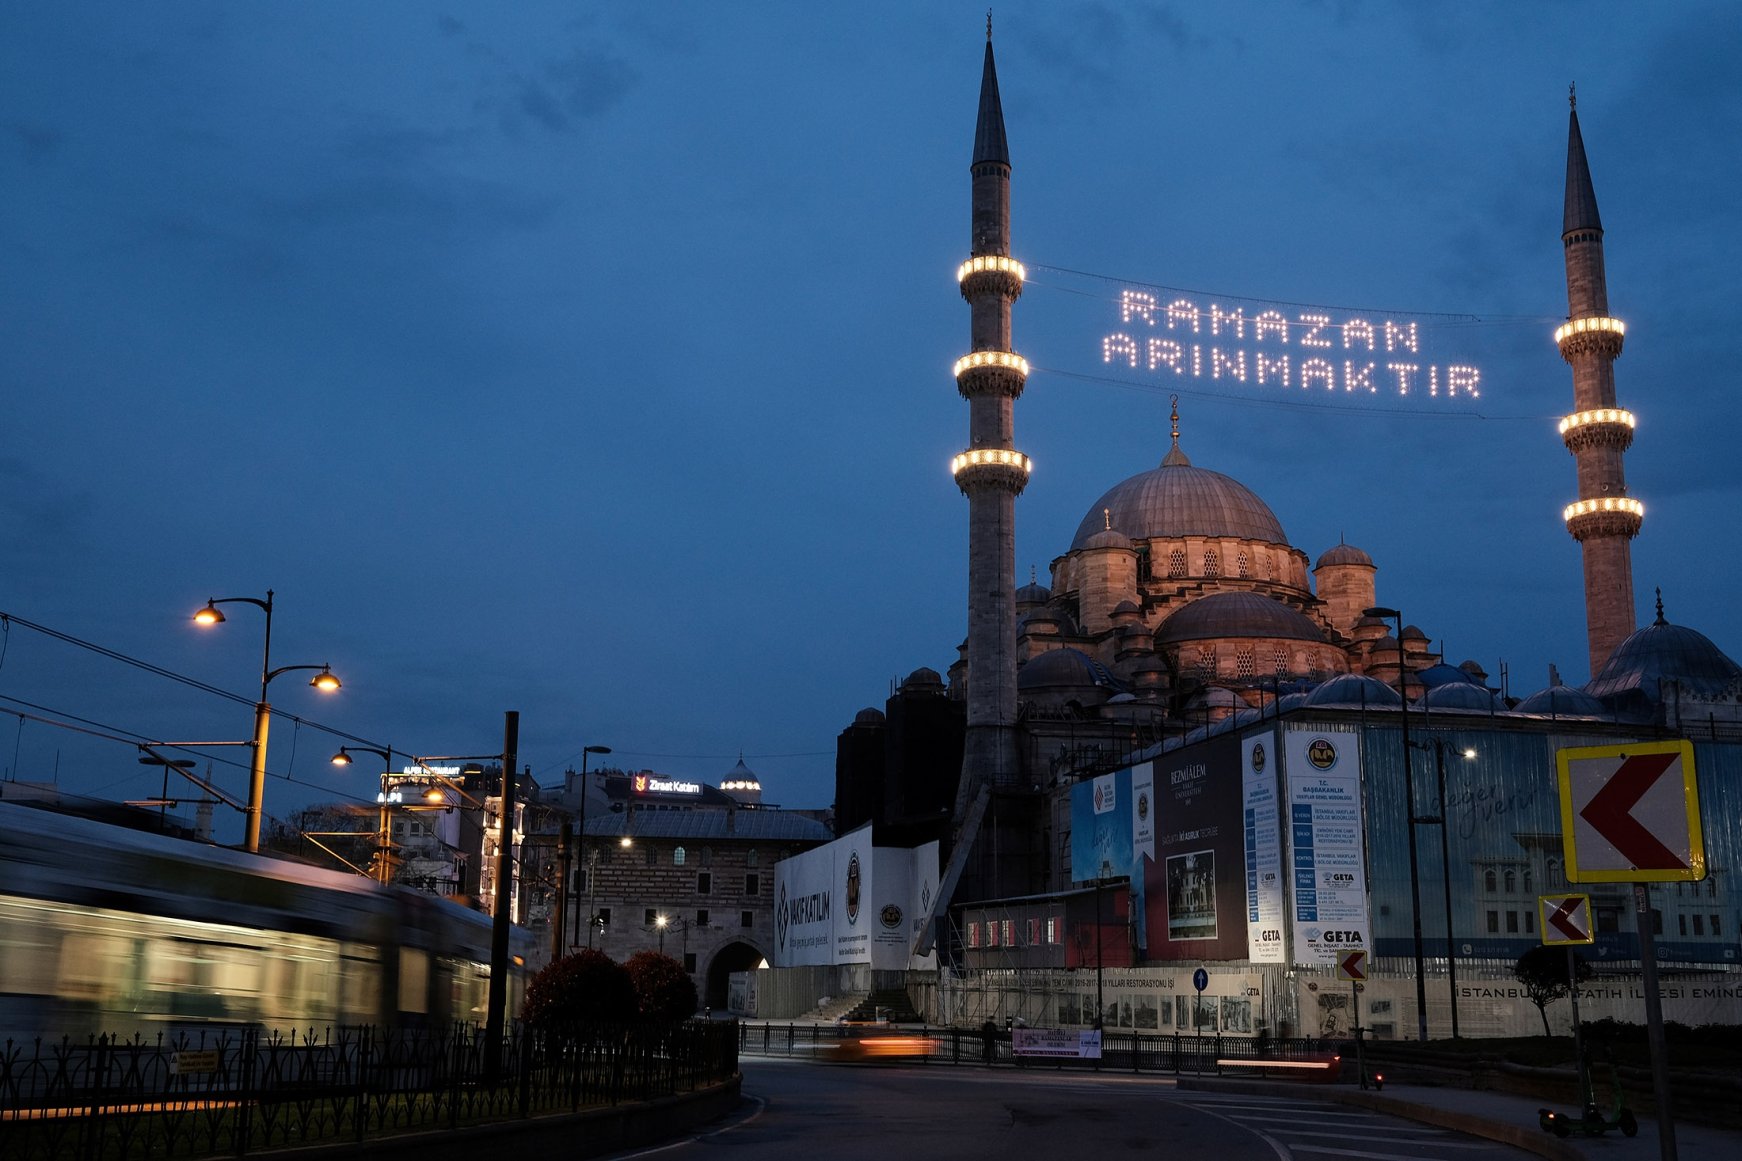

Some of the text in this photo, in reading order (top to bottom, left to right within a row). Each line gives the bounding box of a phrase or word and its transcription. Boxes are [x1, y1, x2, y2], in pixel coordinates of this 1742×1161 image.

[1122, 289, 1420, 353] RAMAZAN
[1103, 331, 1481, 399] ARINMAKTIR
[649, 779, 673, 791] Ziraat
[1303, 786, 1345, 794] BAŞBAKANLIK
[1333, 873, 1354, 881] GETA
[1262, 929, 1281, 942] GETA
[1323, 930, 1363, 943] GETA
[1126, 979, 1167, 988] RESTORASYONU
[1246, 987, 1260, 997] GETA
[1456, 984, 1532, 999] İSTANBU
[1578, 986, 1622, 999] FATİH
[1629, 985, 1685, 999] İLESİ
